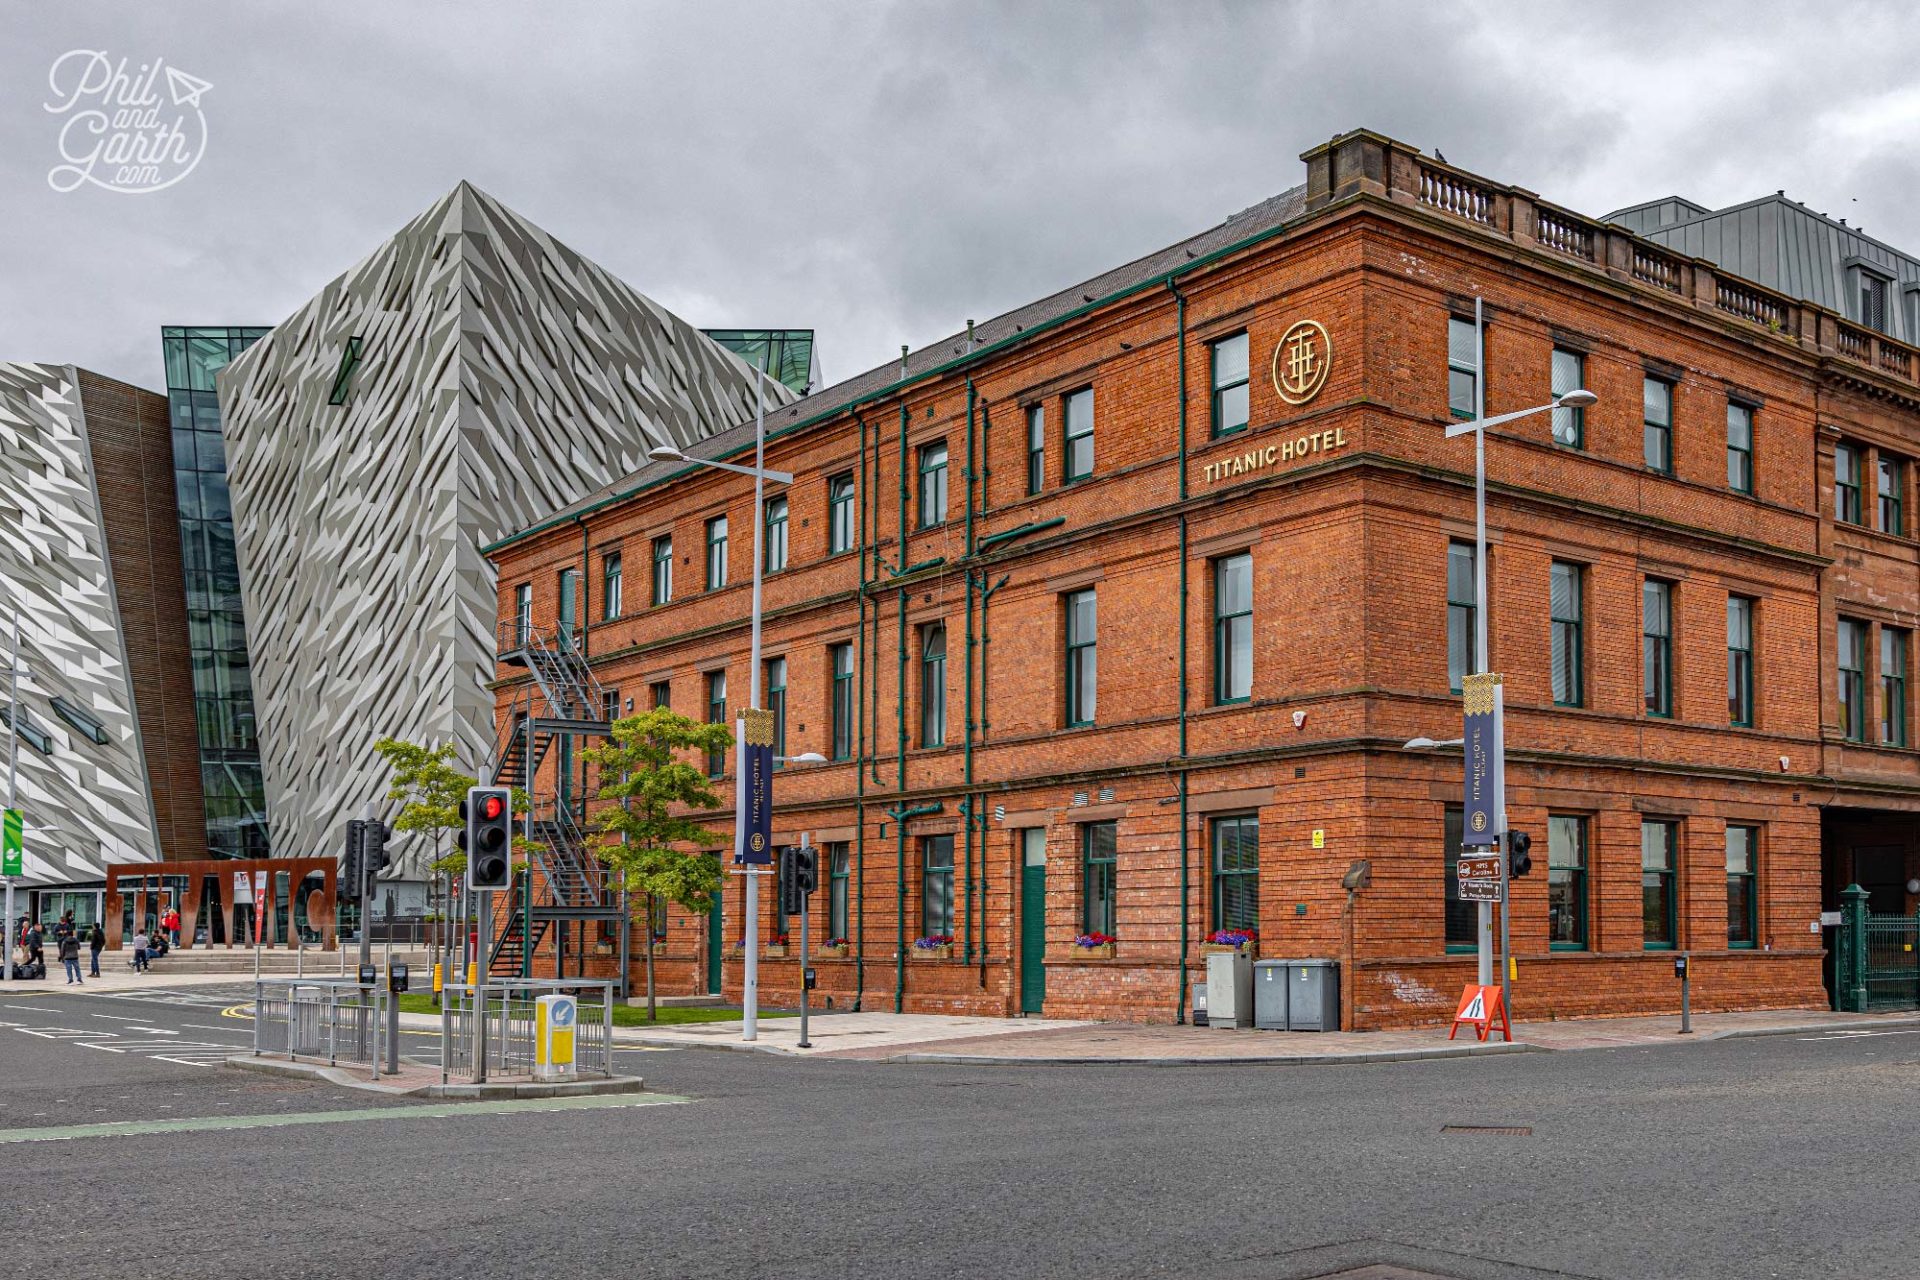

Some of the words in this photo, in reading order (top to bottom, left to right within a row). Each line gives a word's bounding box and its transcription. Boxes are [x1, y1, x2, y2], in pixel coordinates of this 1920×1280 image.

[1203, 446, 1277, 483] TITANIC
[1282, 427, 1346, 461] HOTEL
[112, 866, 328, 950] TITANIC
